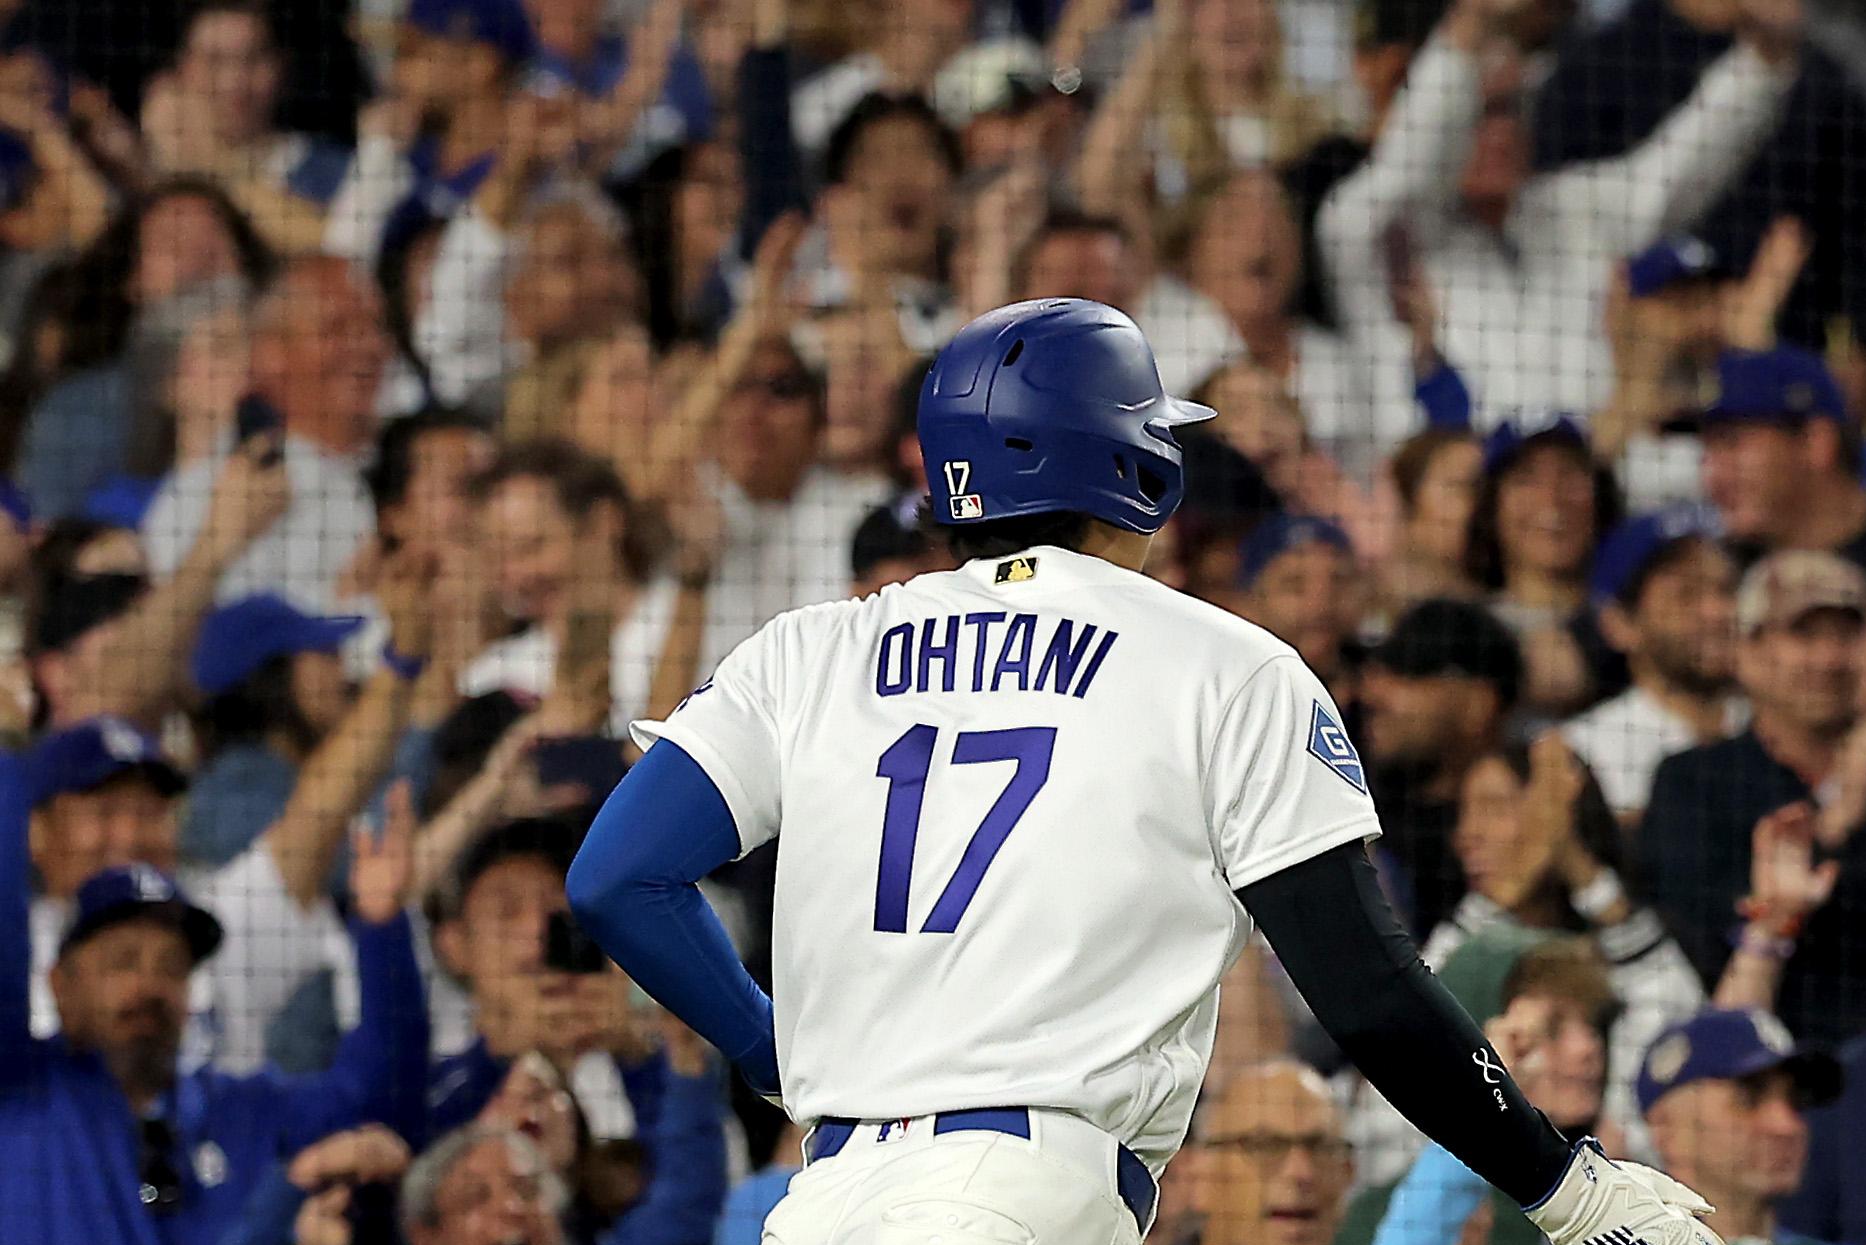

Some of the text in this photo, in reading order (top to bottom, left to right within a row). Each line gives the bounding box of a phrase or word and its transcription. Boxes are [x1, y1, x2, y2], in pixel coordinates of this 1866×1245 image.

[943, 460, 971, 496] 17
[875, 610, 1120, 700] OHTANI
[1319, 725, 1351, 757] G
[873, 722, 1059, 935] 17
